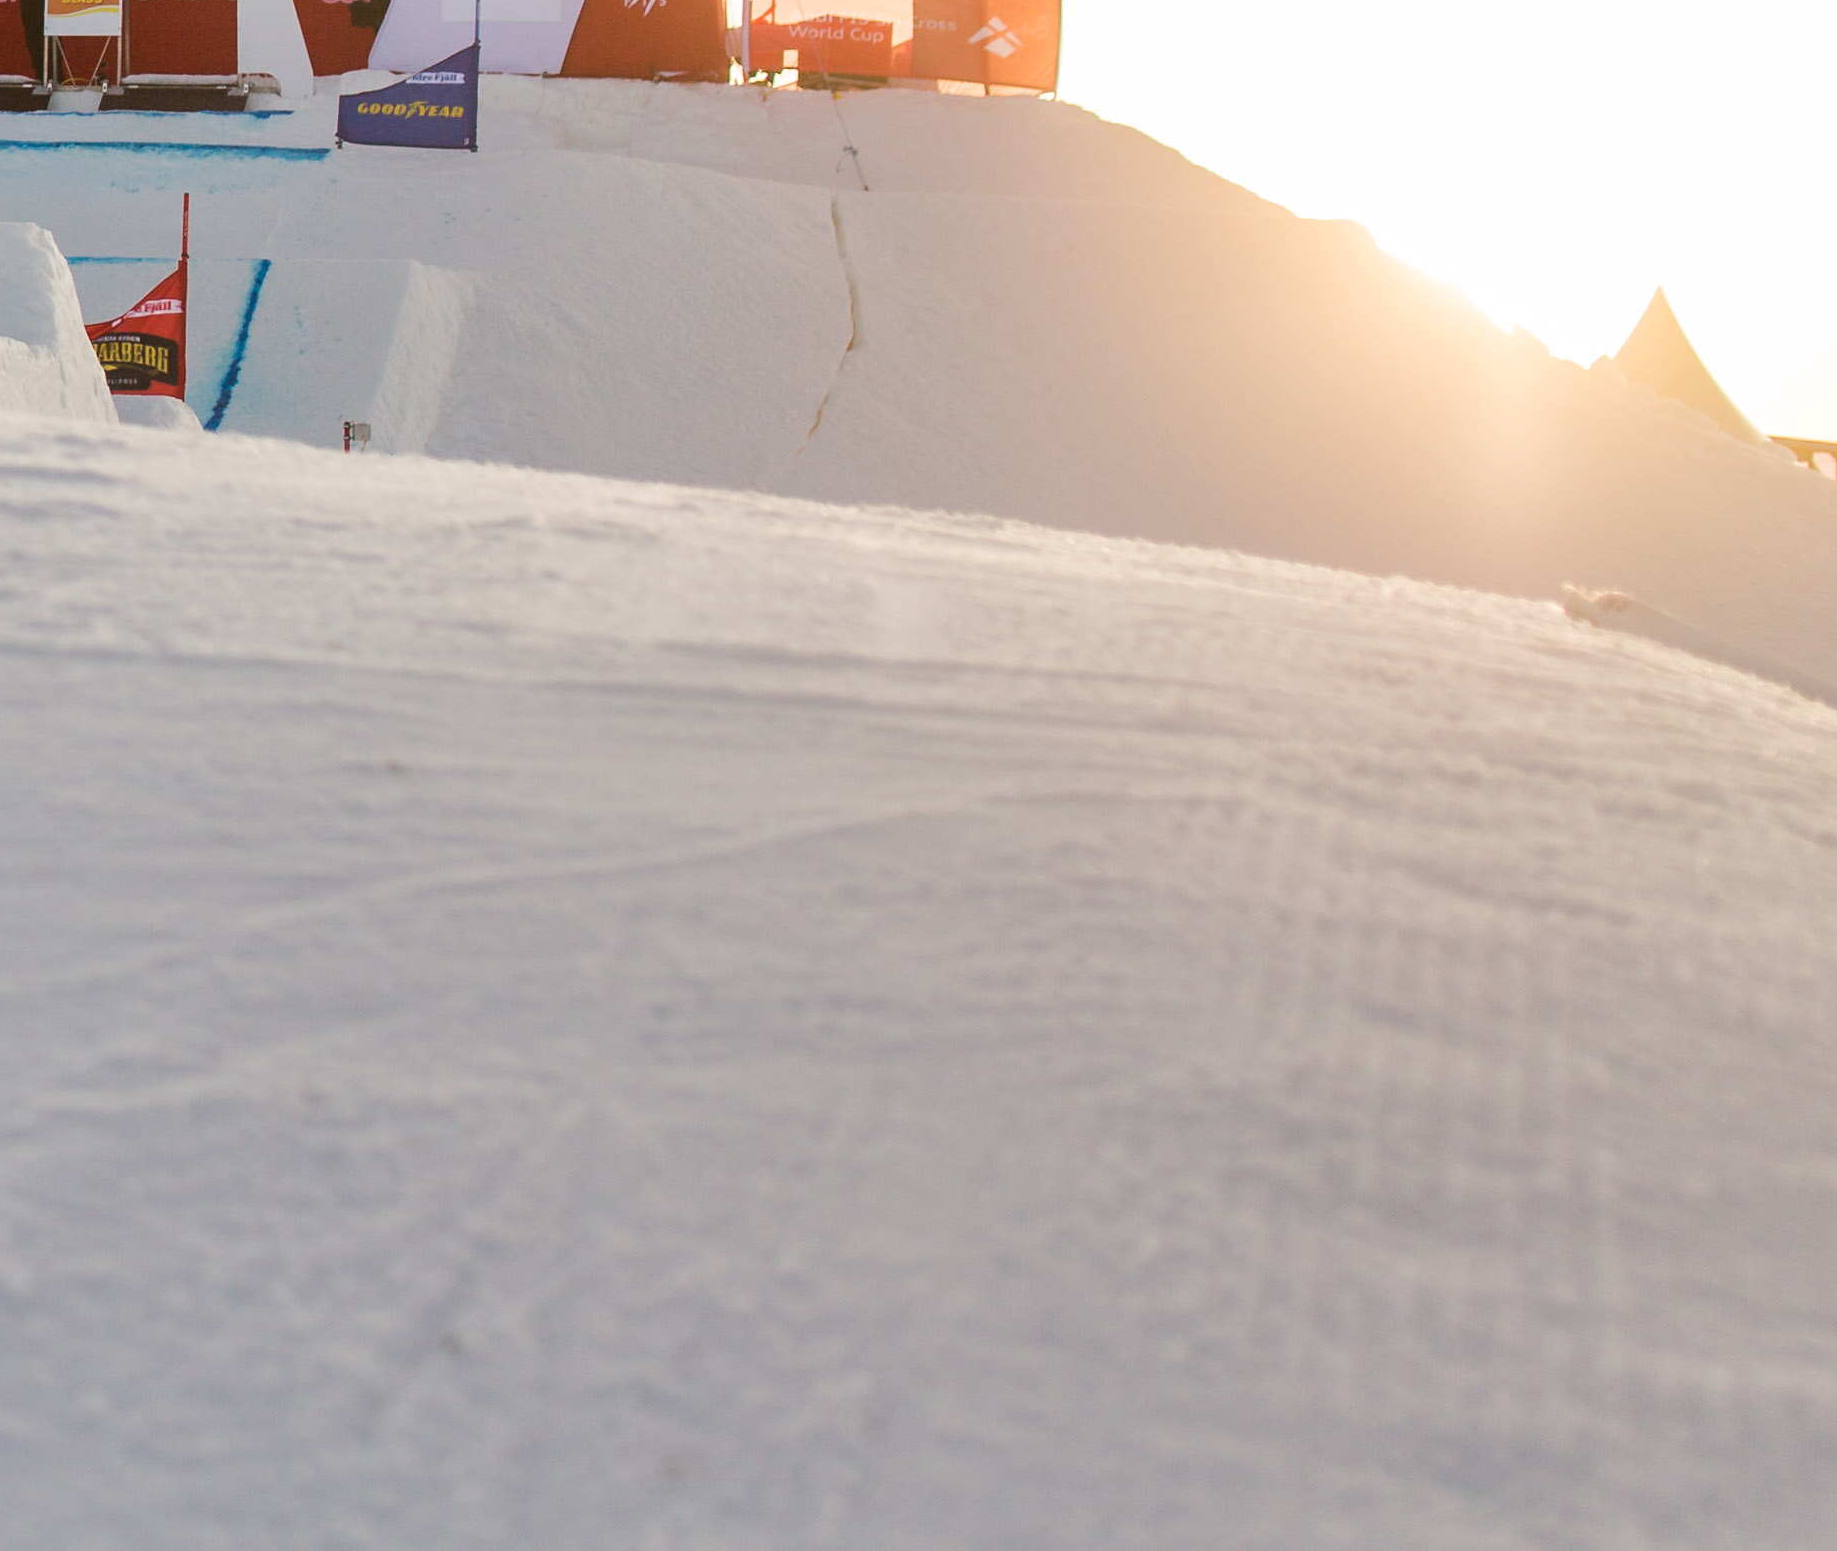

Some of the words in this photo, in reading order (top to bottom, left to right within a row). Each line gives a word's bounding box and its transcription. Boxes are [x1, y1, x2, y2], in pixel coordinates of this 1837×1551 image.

[788, 25, 845, 41] World
[850, 28, 885, 44] Cup
[357, 101, 465, 118] GOODYEAR
